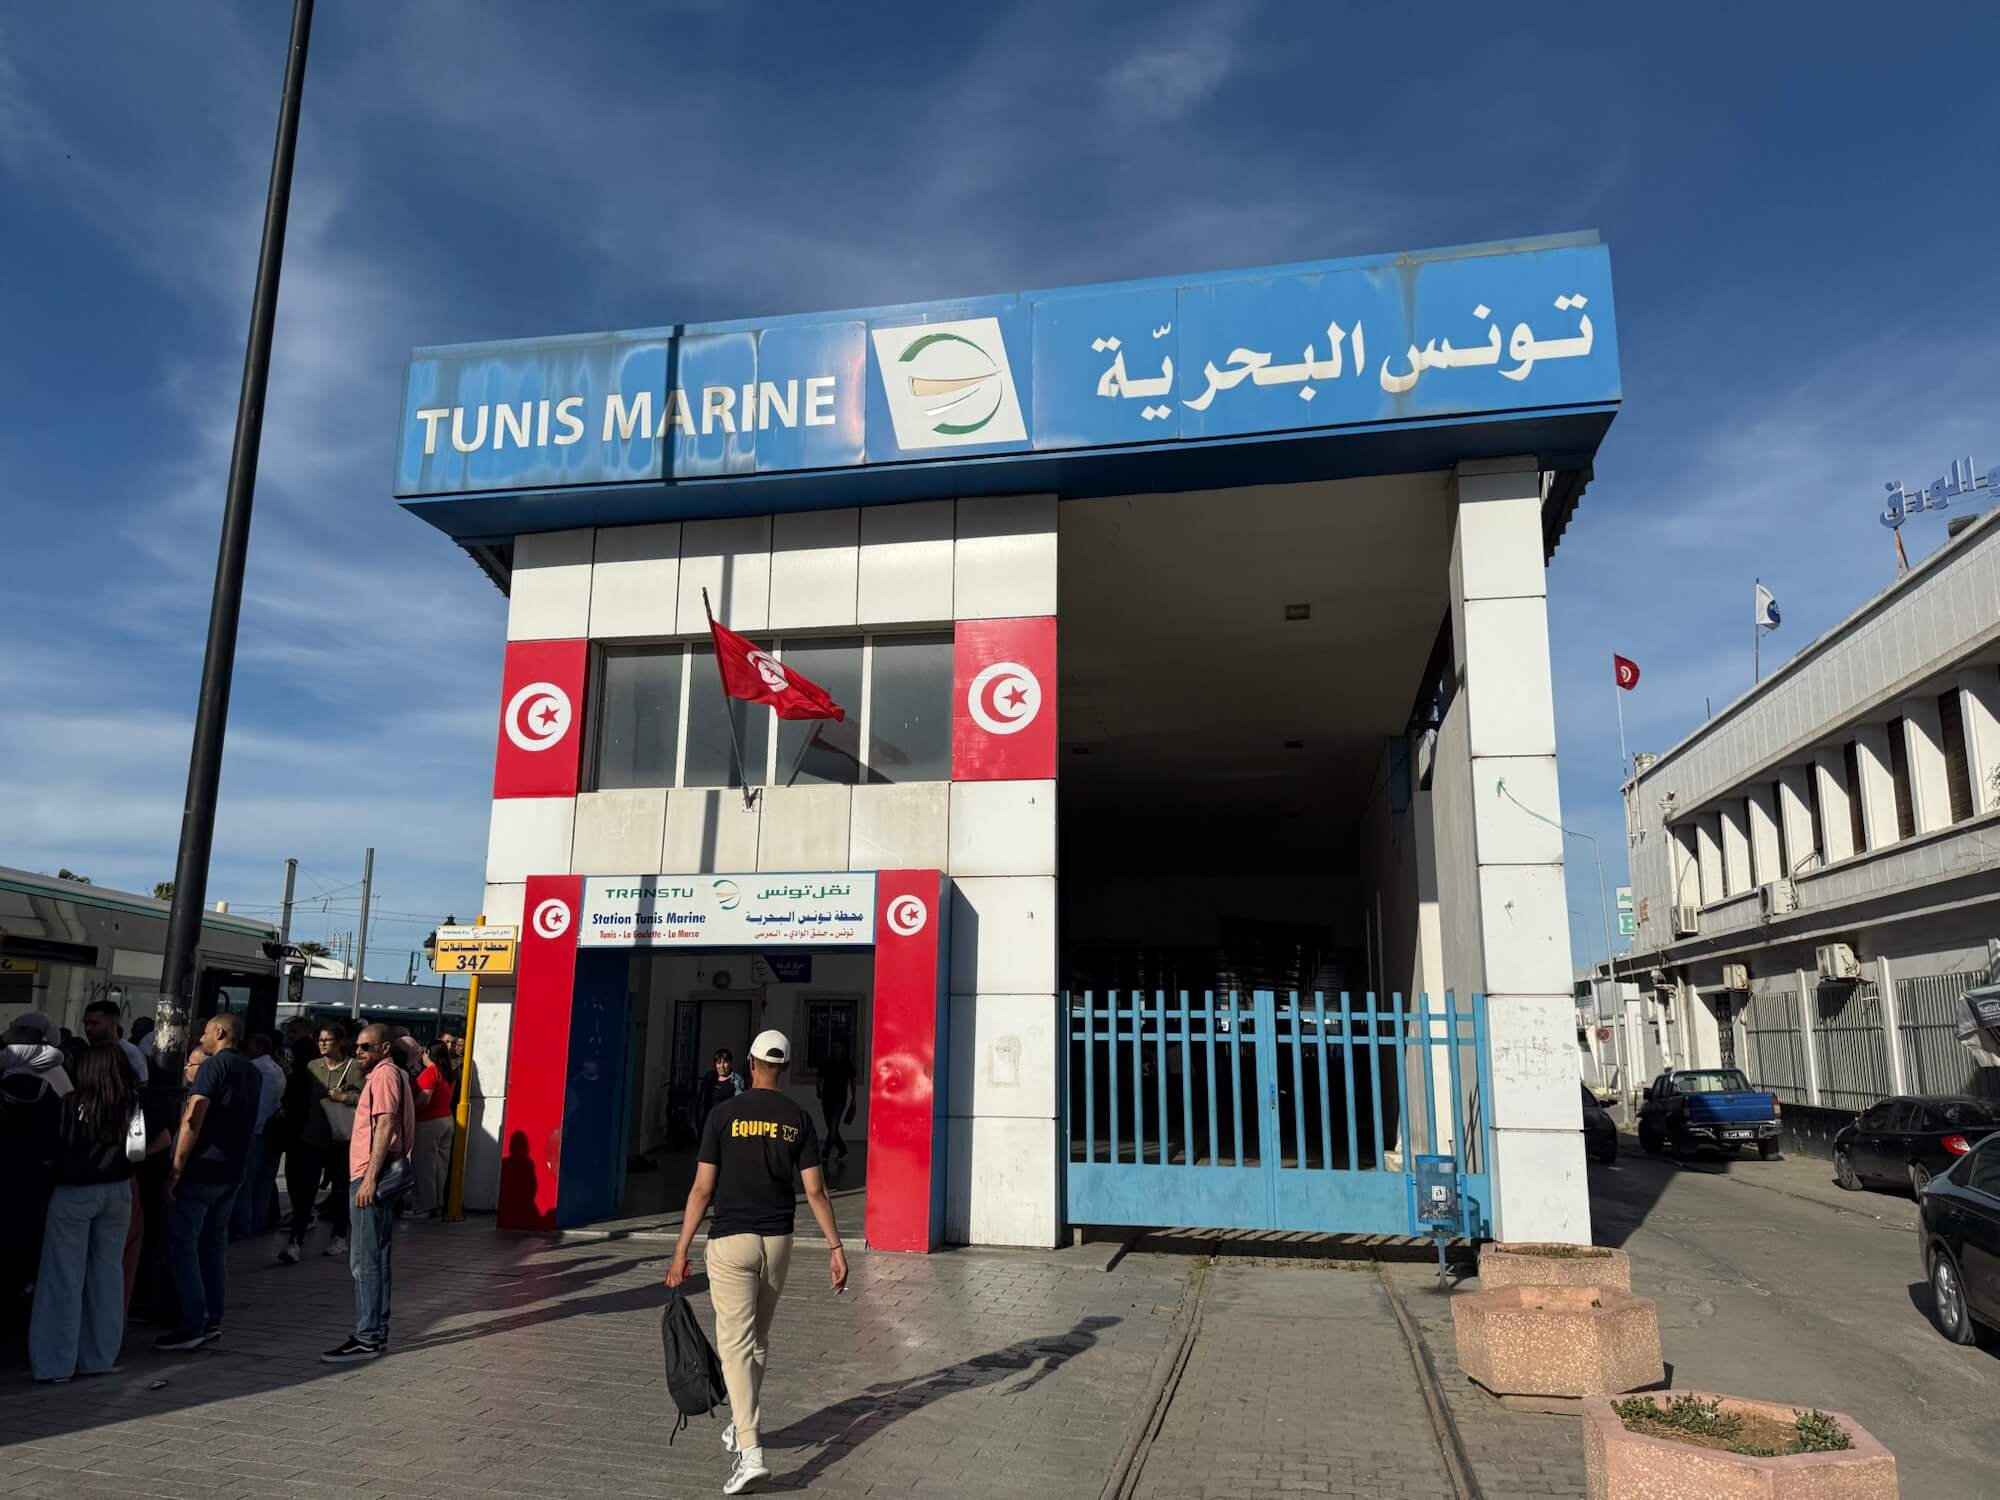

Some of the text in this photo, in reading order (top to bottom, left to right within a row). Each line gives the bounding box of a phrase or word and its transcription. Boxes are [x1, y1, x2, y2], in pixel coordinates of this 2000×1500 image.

[1379, 293, 1594, 394] تونس
[416, 375, 837, 455] TUNIS MARINE
[604, 888, 694, 899] TRANSTU
[757, 885, 851, 900] نقل تونس
[592, 911, 706, 925] Station Tunis Marine
[745, 910, 864, 926] محطة تونس البحرية
[600, 930, 617, 939] Tunis
[623, 930, 632, 938] La
[668, 930, 676, 938] La
[677, 929, 700, 938] Marsa
[456, 954, 490, 970] 347
[731, 1118, 779, 1138] ÉQUIPE
